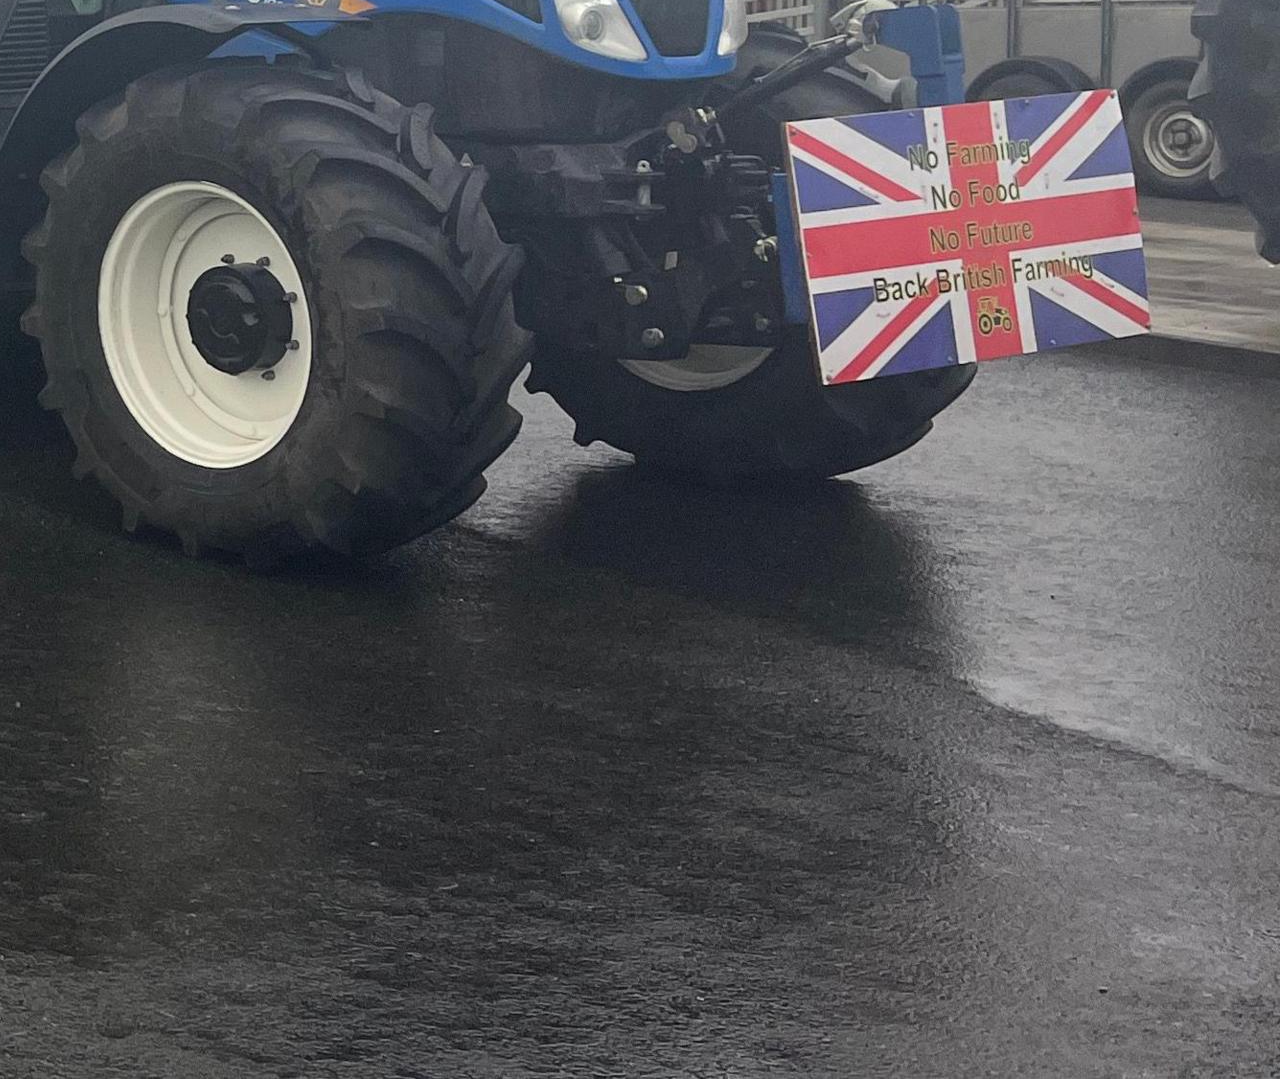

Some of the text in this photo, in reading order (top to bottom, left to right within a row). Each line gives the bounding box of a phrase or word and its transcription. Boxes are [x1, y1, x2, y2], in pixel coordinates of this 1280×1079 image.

[906, 138, 1032, 171] No Farming
[930, 176, 1021, 211] No Food
[929, 221, 1034, 253] No Future
[872, 251, 1095, 303] Back British Farming
